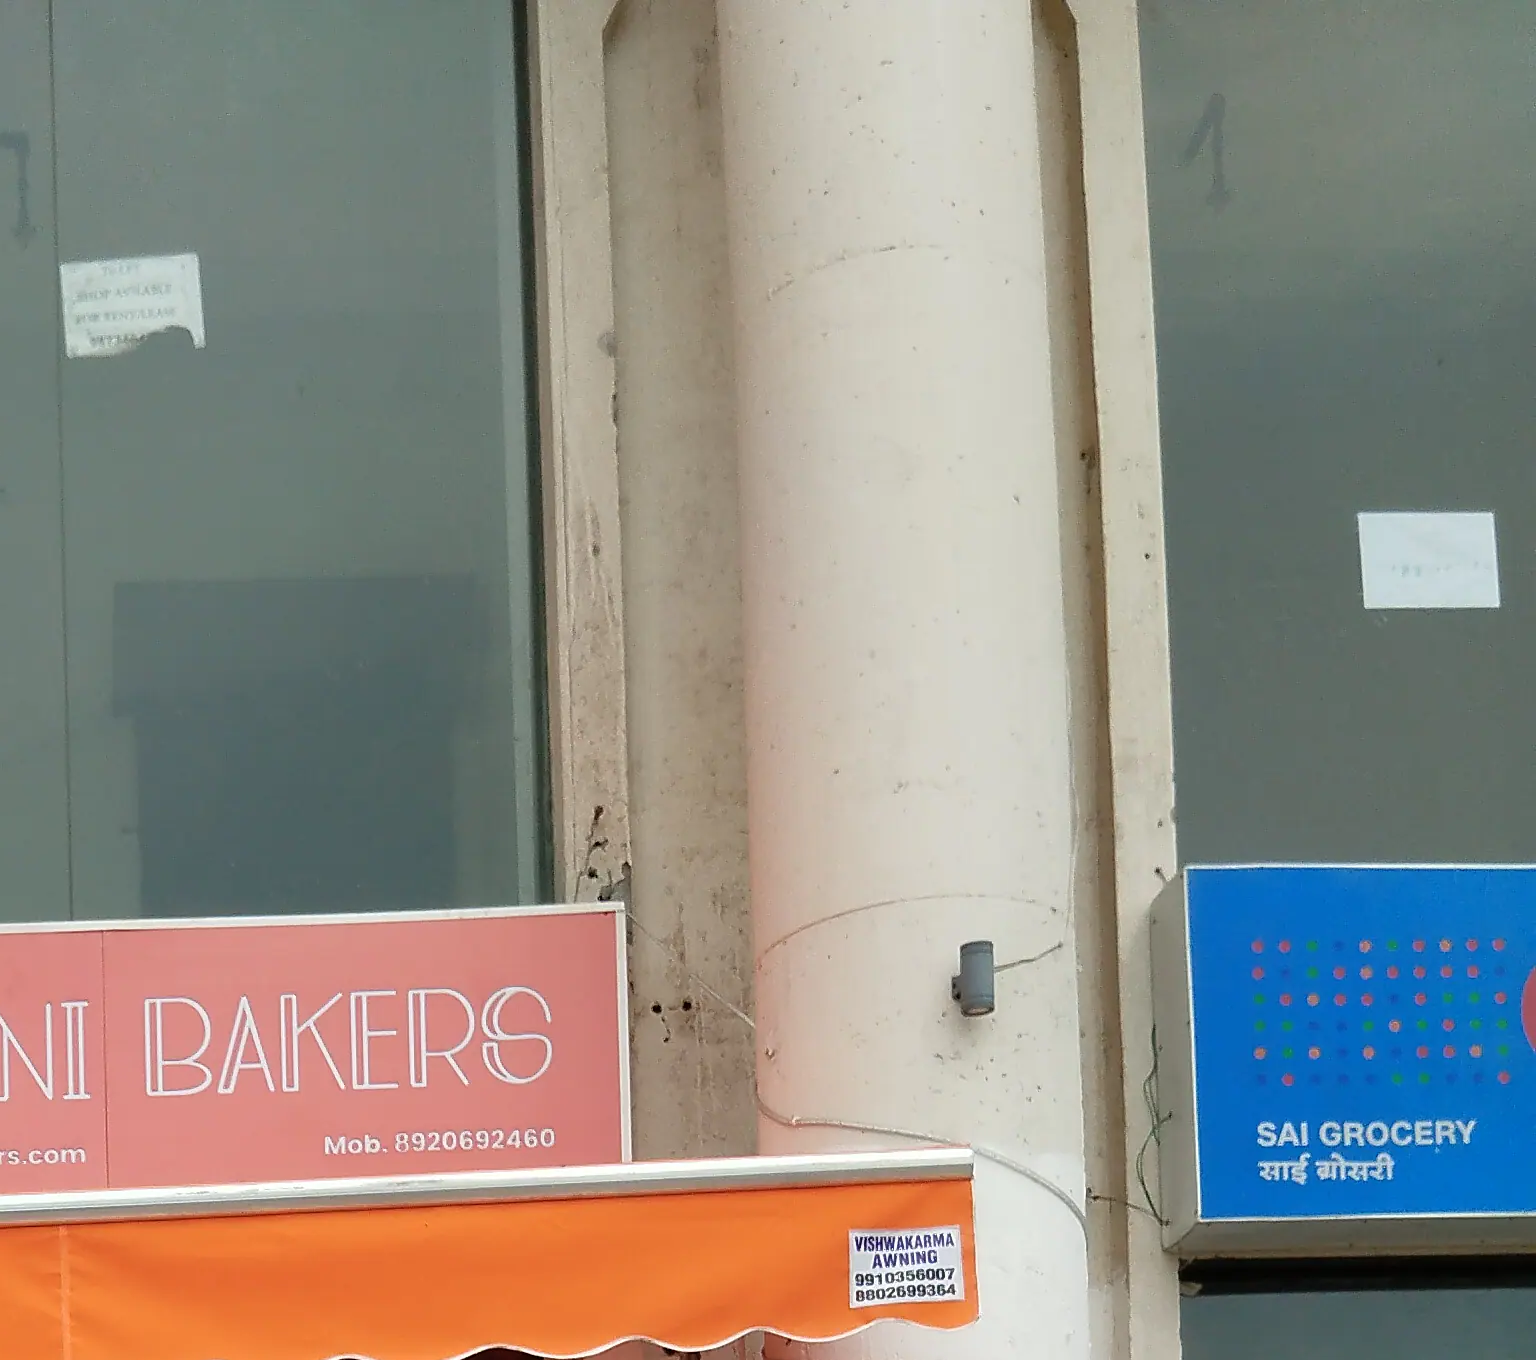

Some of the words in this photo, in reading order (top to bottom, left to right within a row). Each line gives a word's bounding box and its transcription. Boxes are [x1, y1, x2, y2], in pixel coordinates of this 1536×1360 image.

[144, 986, 553, 1097] BAKERS
[324, 1134, 388, 1156] Mob.
[395, 1128, 555, 1152] 8920692460
[1257, 1121, 1309, 1147] SAI
[1319, 1119, 1477, 1147] GROCERY
[1257, 1152, 1311, 1185] साई
[854, 1233, 955, 1252] VISHWAKARMA
[872, 1250, 938, 1269] AWNING
[855, 1268, 955, 1287] 9910356007
[855, 1284, 956, 1302] 8802699364
